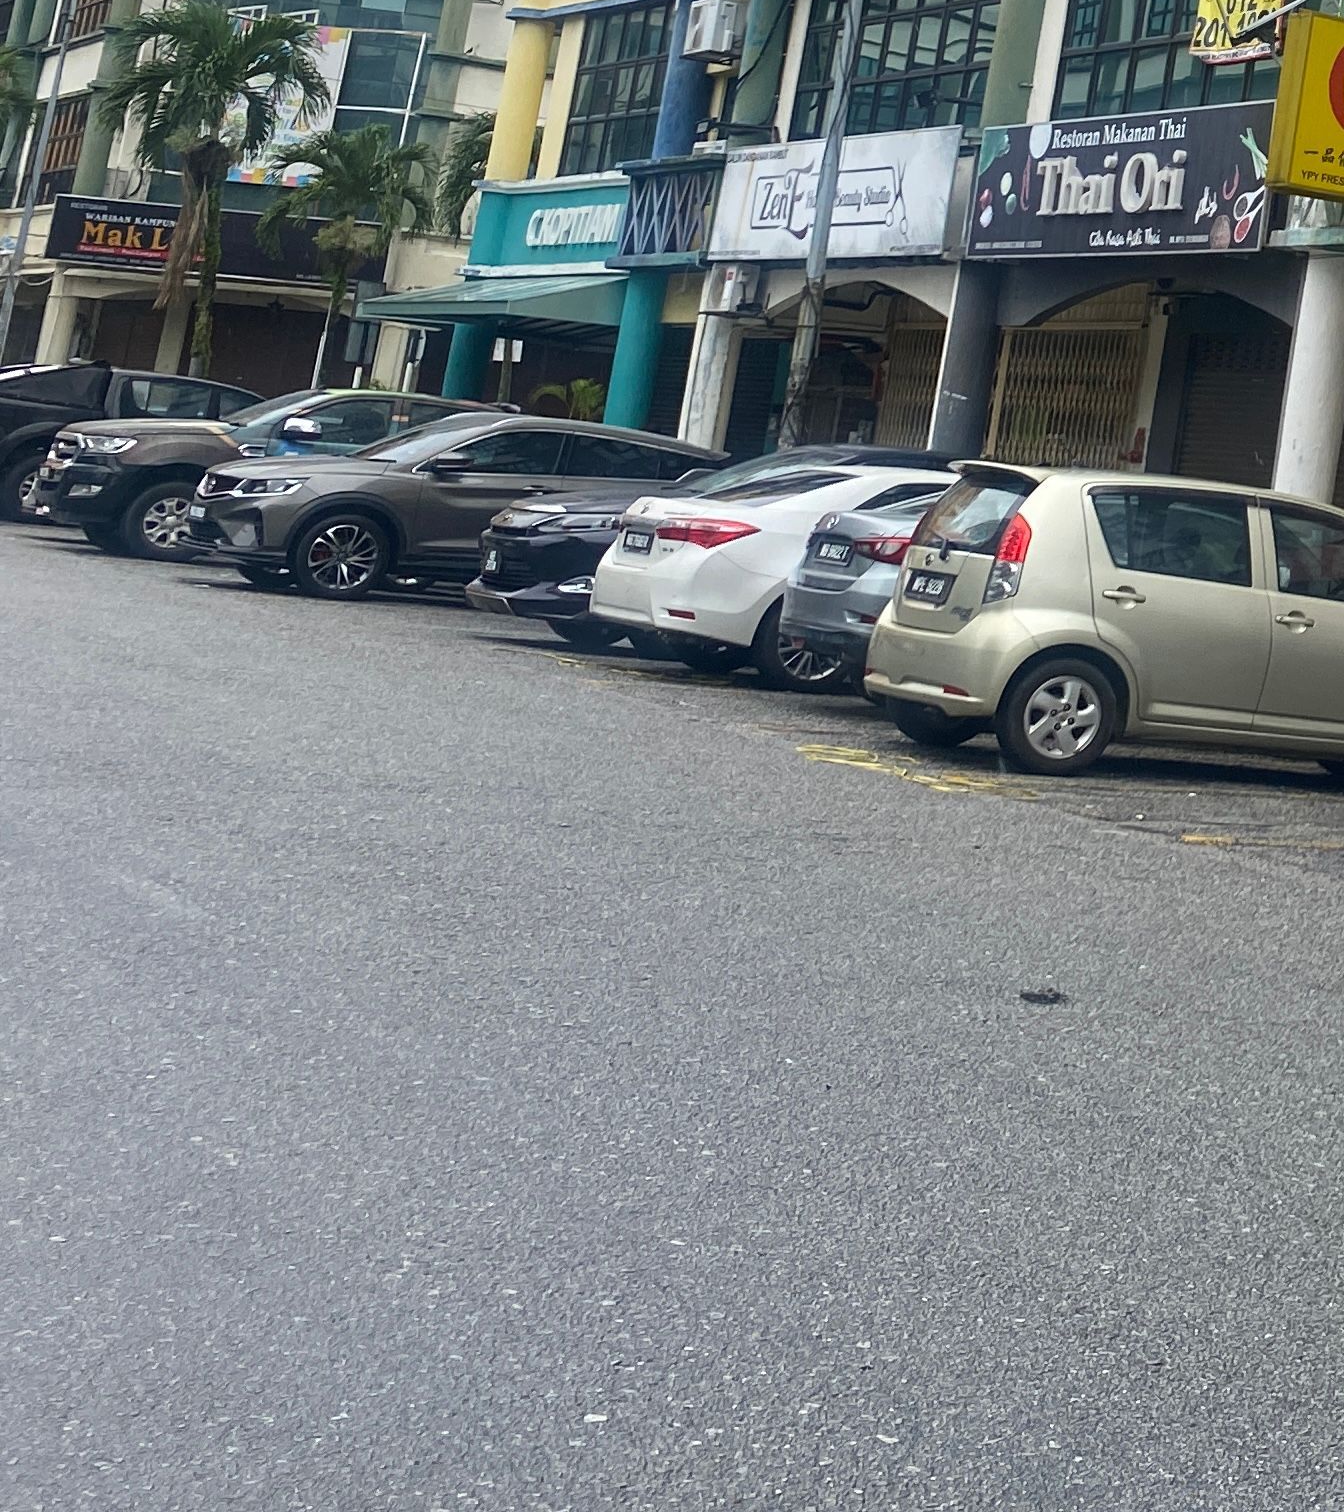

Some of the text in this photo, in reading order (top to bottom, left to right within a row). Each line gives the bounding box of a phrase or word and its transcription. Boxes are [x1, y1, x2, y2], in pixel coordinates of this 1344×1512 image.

[1052, 117, 1187, 150] Restoran Makanan Thai
[1036, 149, 1188, 217] Thai Ori
[1302, 170, 1319, 182] YPY
[85, 213, 178, 228] WARISAN KAMPUN
[80, 221, 143, 248] Mak
